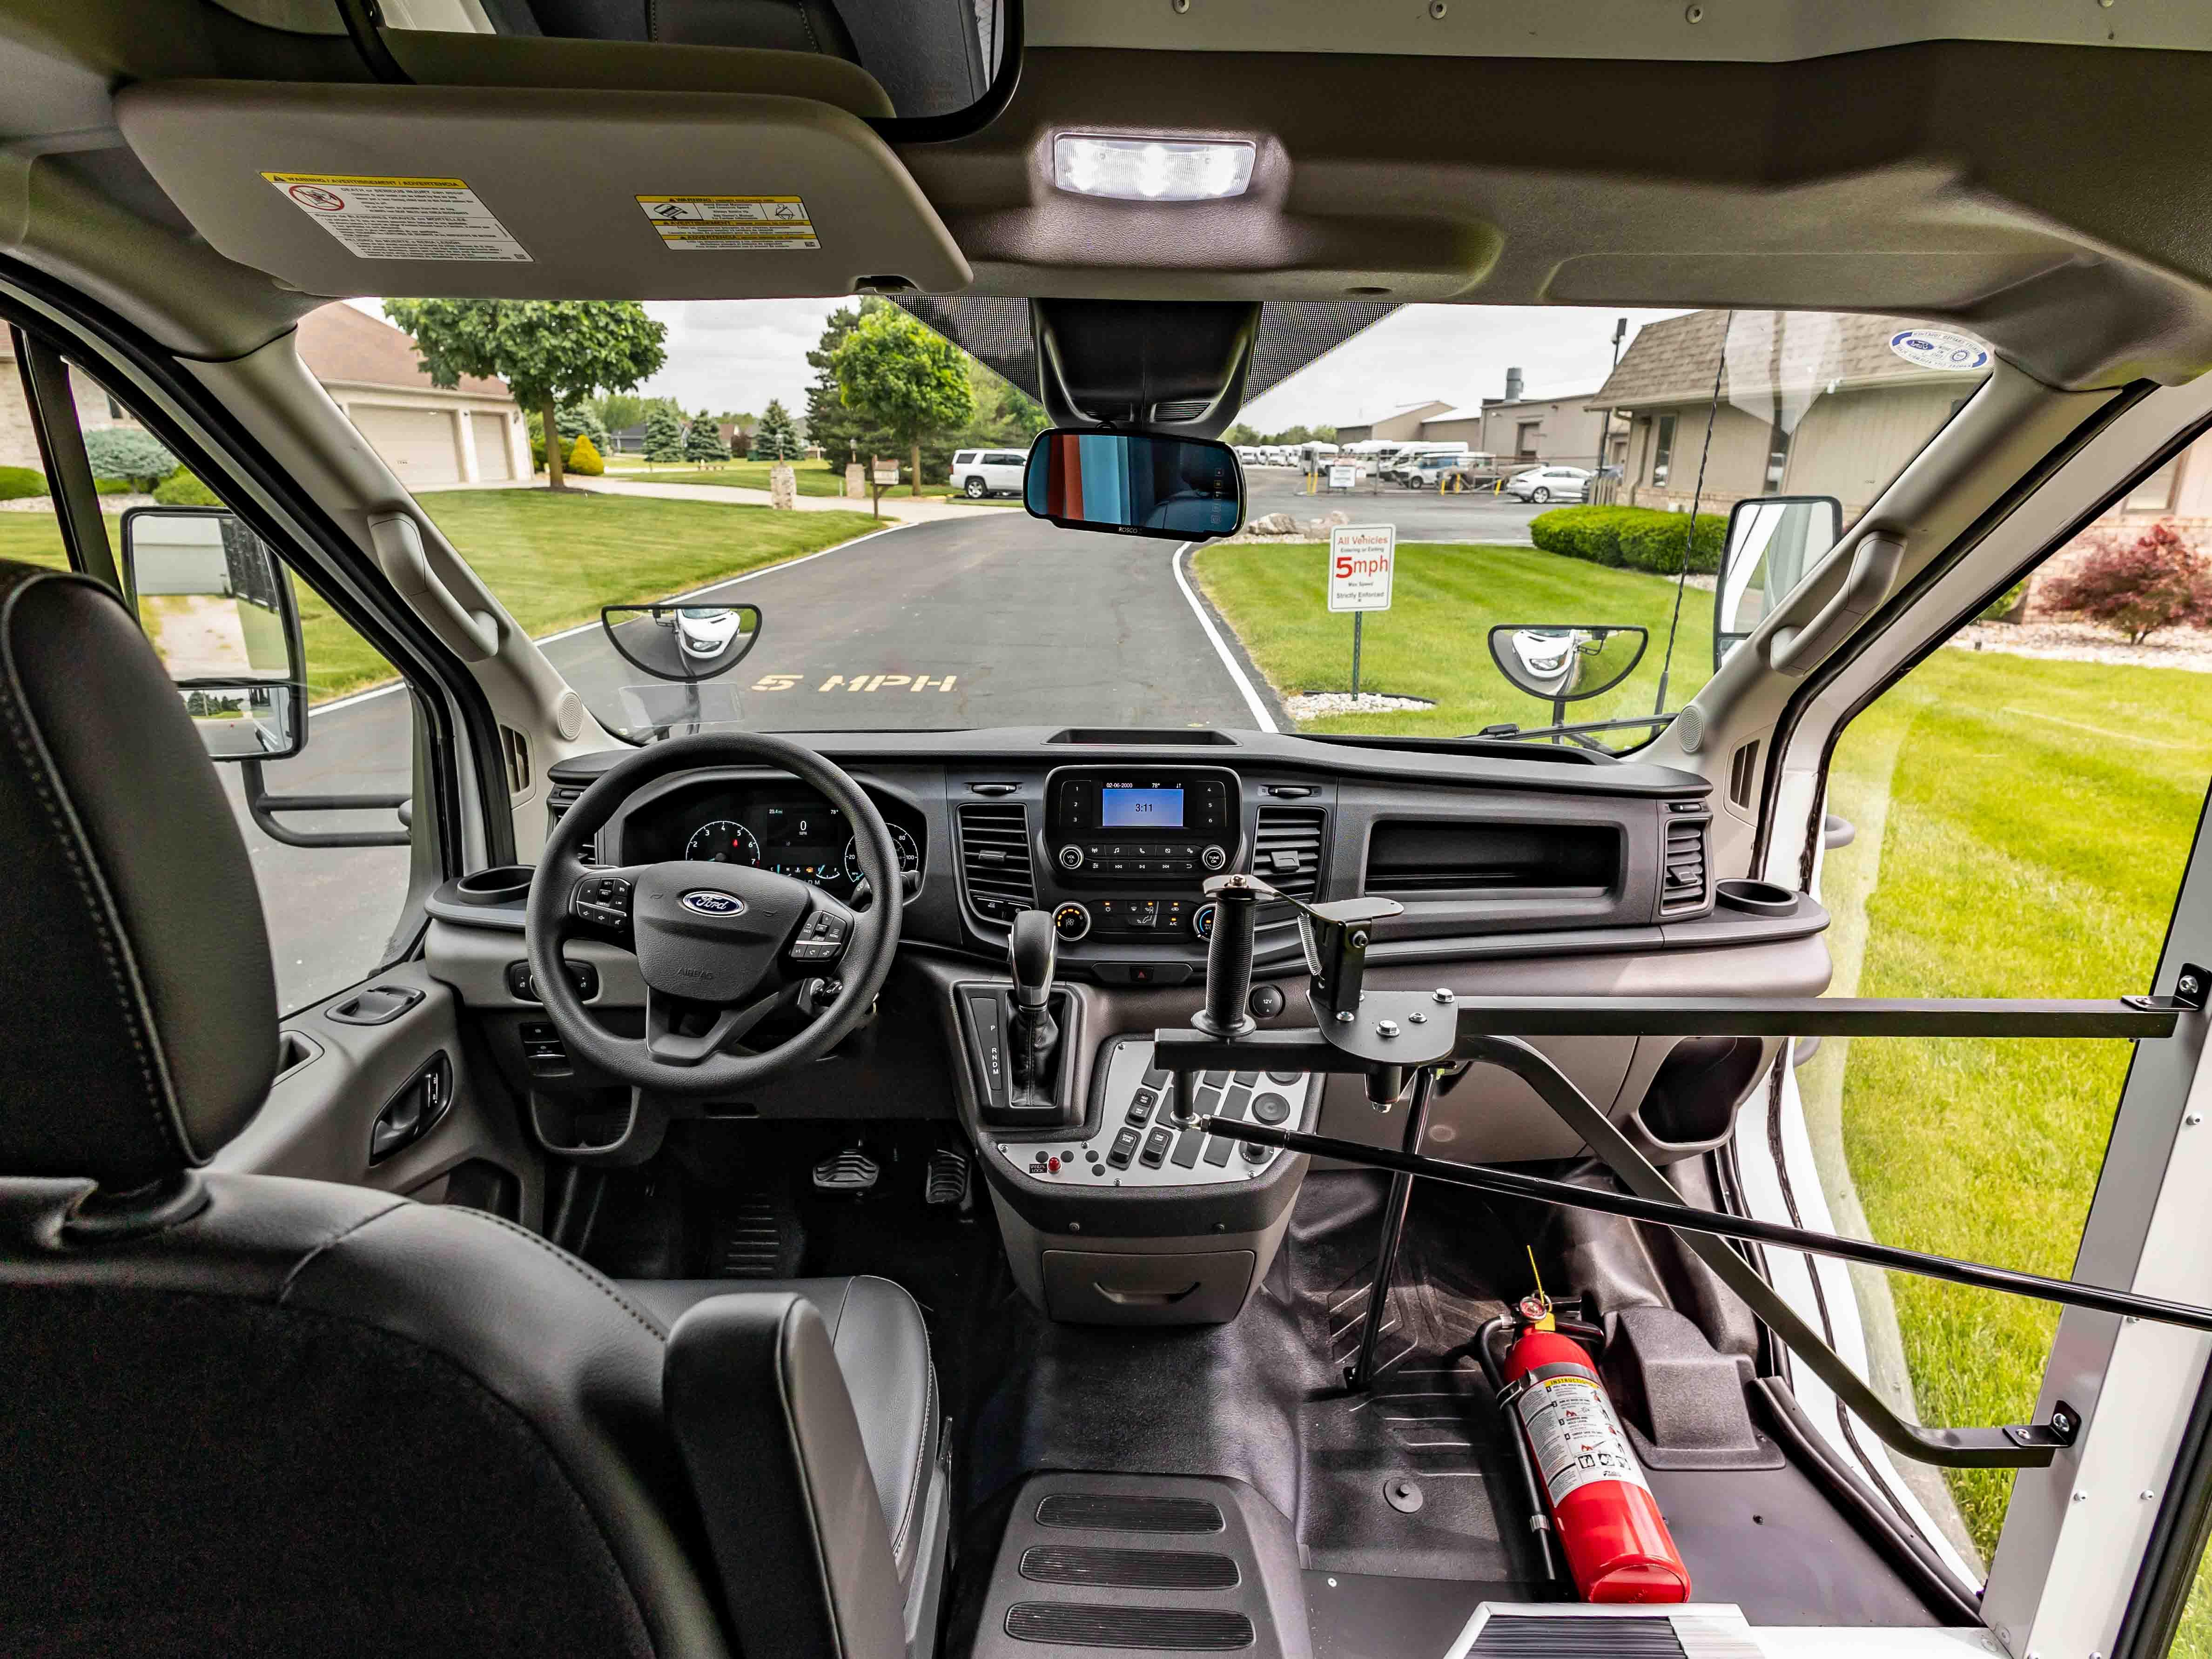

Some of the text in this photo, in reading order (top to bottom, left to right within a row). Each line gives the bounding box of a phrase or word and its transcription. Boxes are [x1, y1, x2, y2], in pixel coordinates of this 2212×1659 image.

[750, 674, 957, 692] 5 MPH
[1136, 804, 1153, 812] 3:11
[800, 820, 807, 831] 0
[695, 895, 729, 910] Ford
